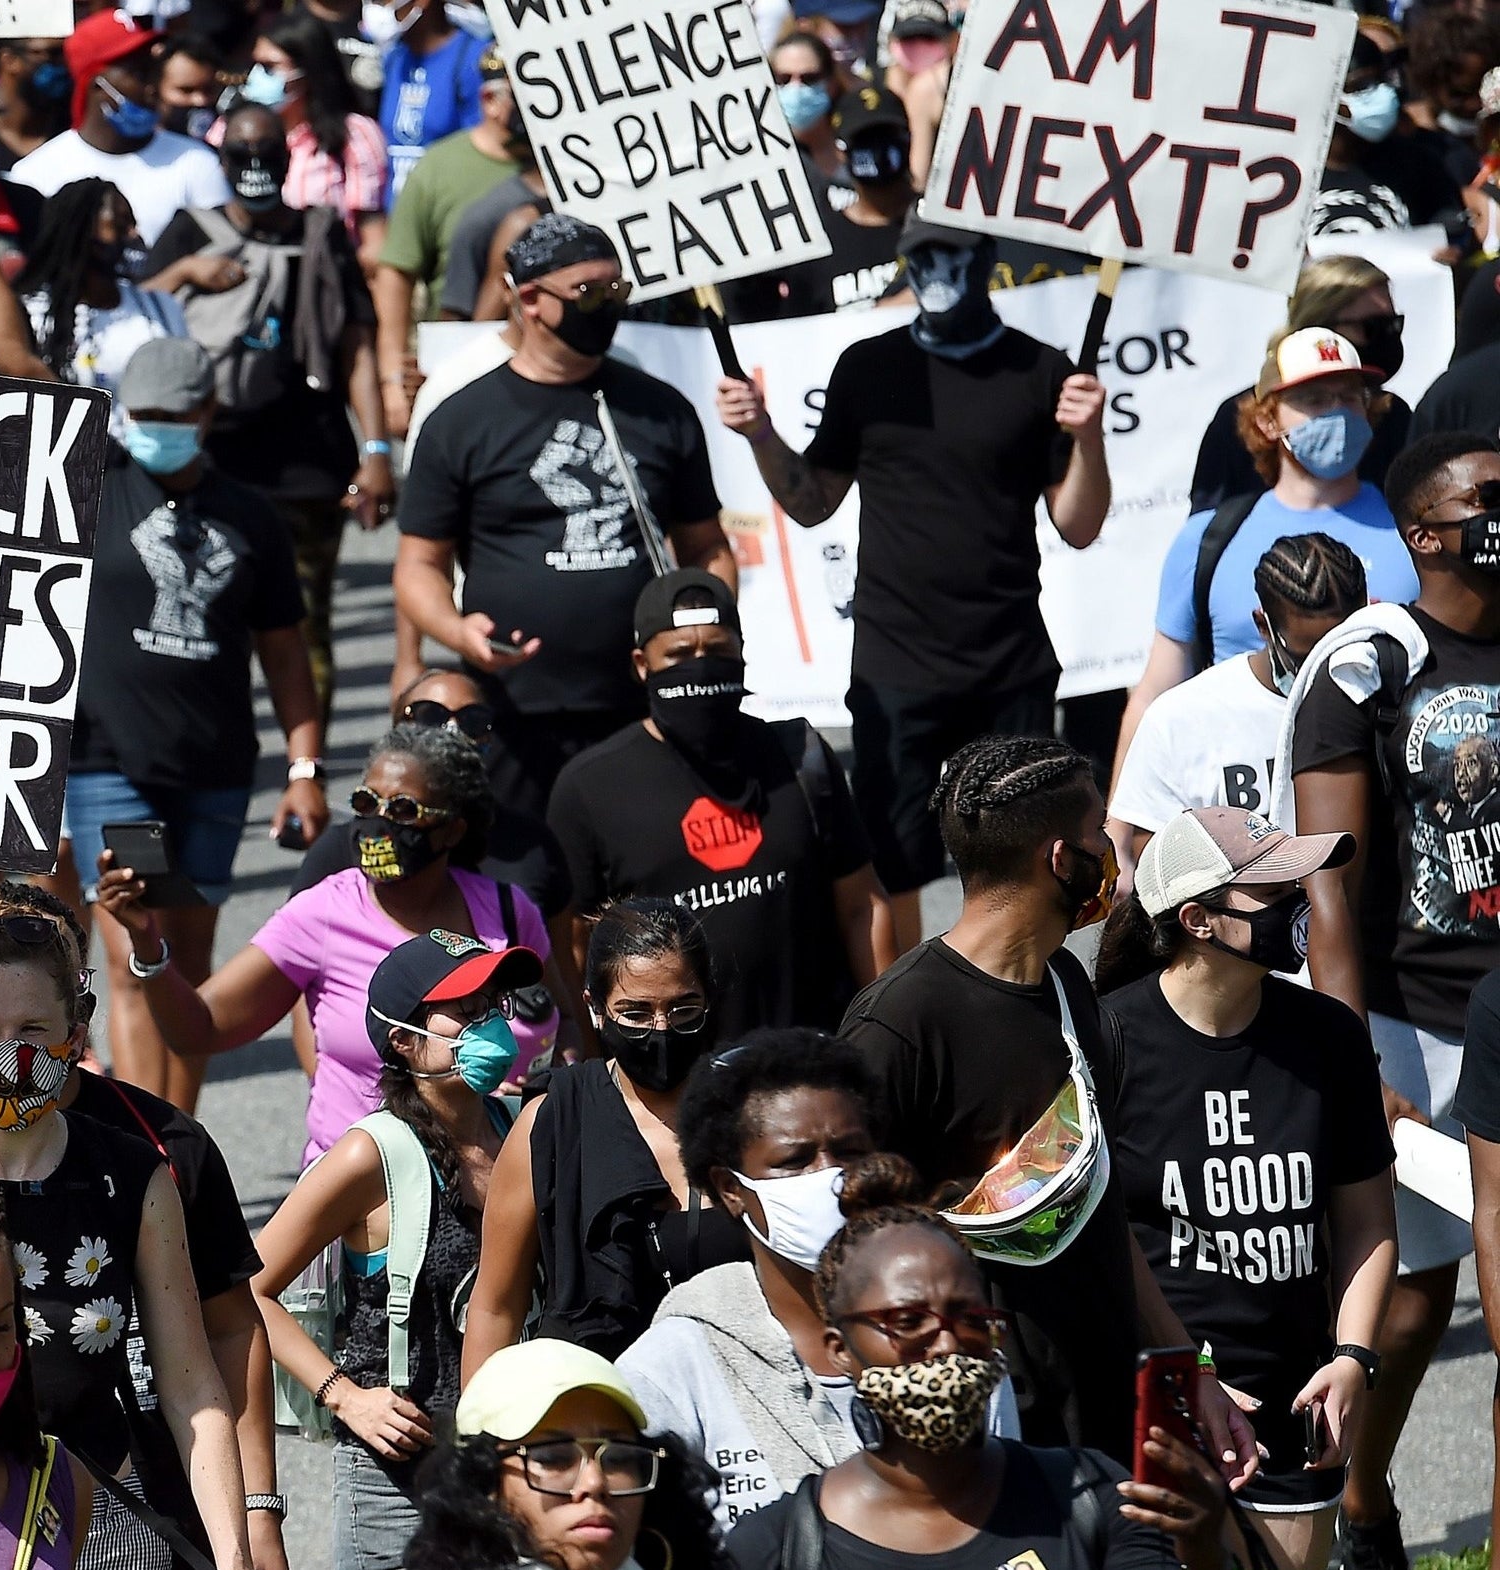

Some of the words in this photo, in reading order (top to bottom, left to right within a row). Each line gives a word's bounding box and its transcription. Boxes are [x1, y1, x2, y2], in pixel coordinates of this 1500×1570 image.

[515, 0, 763, 120] SILENCE
[1203, 10, 1316, 132] I
[541, 134, 604, 202] IS
[614, 86, 791, 188] BLACK
[945, 106, 1302, 271] NEXT?
[618, 168, 811, 287] EATH
[1408, 714, 1430, 766] AUGUST
[1435, 712, 1489, 736] 2020
[687, 814, 760, 852] STOP
[1446, 828, 1479, 864] GET
[673, 876, 762, 911] KILLING
[1204, 1089, 1255, 1146] BE
[1162, 1160, 1190, 1216] A
[1203, 1151, 1313, 1217] GOOD
[1169, 1215, 1319, 1284] PERSON.
[716, 1449, 765, 1468] Bre
[725, 1473, 767, 1495] Eric
